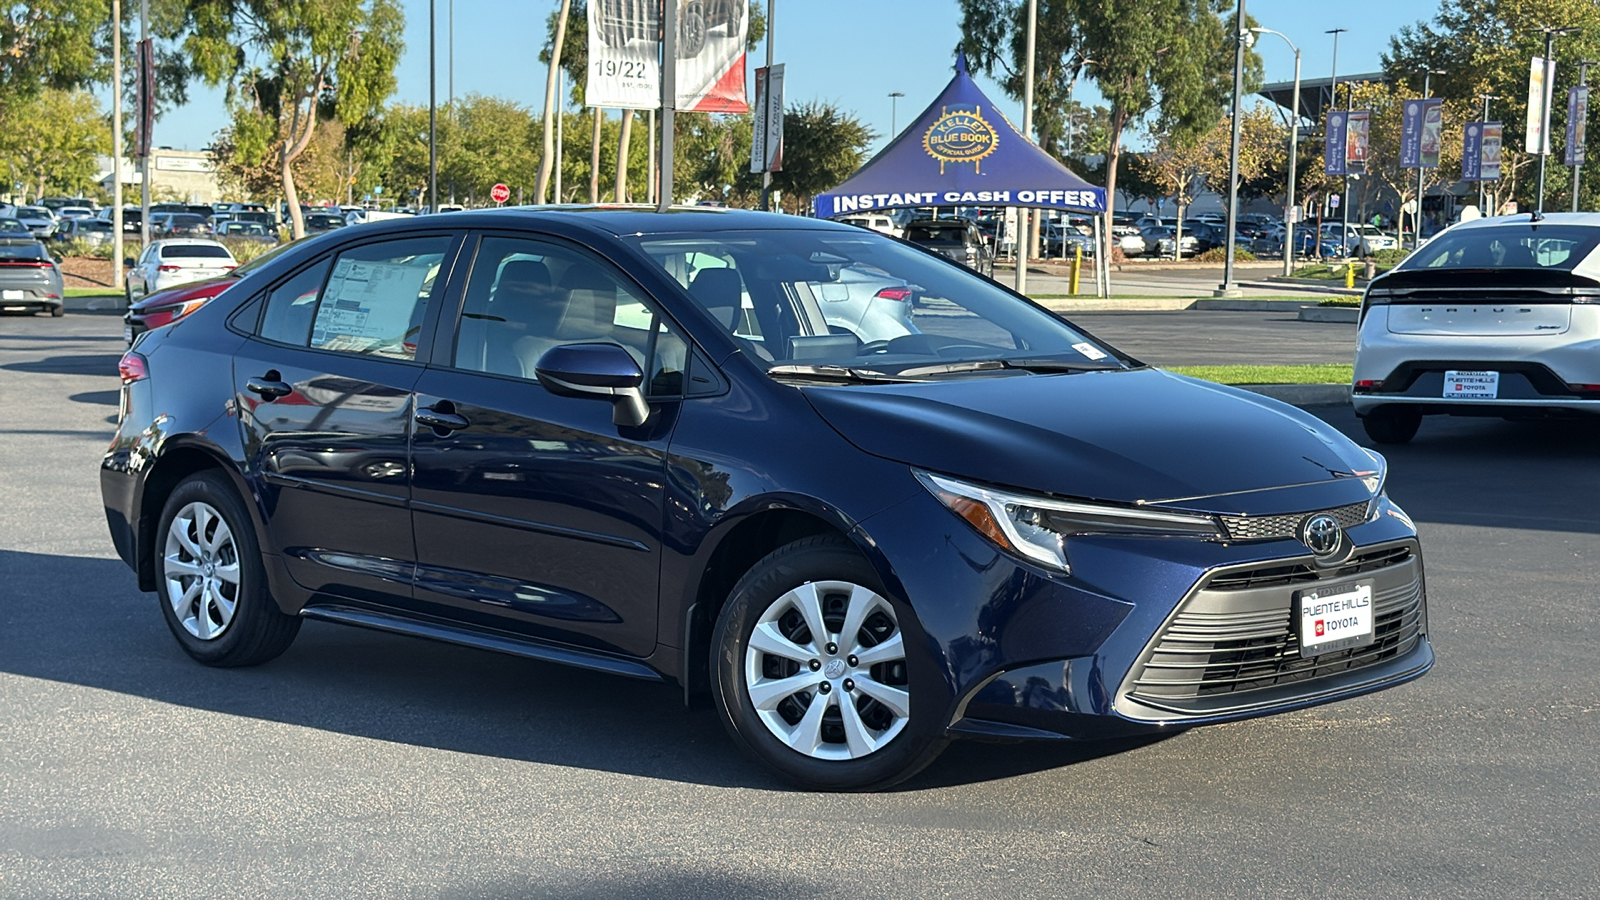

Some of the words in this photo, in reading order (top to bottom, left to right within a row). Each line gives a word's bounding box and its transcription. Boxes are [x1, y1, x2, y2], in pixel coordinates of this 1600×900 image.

[594, 59, 646, 79] 19/22
[937, 117, 987, 132] KELLEY
[930, 132, 959, 144] BLUE
[960, 133, 990, 143] BOOK
[936, 144, 965, 156] OFFICIAL
[964, 144, 985, 155] GUIDE
[492, 188, 508, 198] STOP
[833, 192, 937, 213] INSTANT
[943, 190, 1010, 204] CASH
[1017, 190, 1096, 209] OFFER
[1303, 601, 1340, 617] PUENTE
[1342, 597, 1369, 611] HILLS
[1326, 616, 1359, 631] TOYOTA
